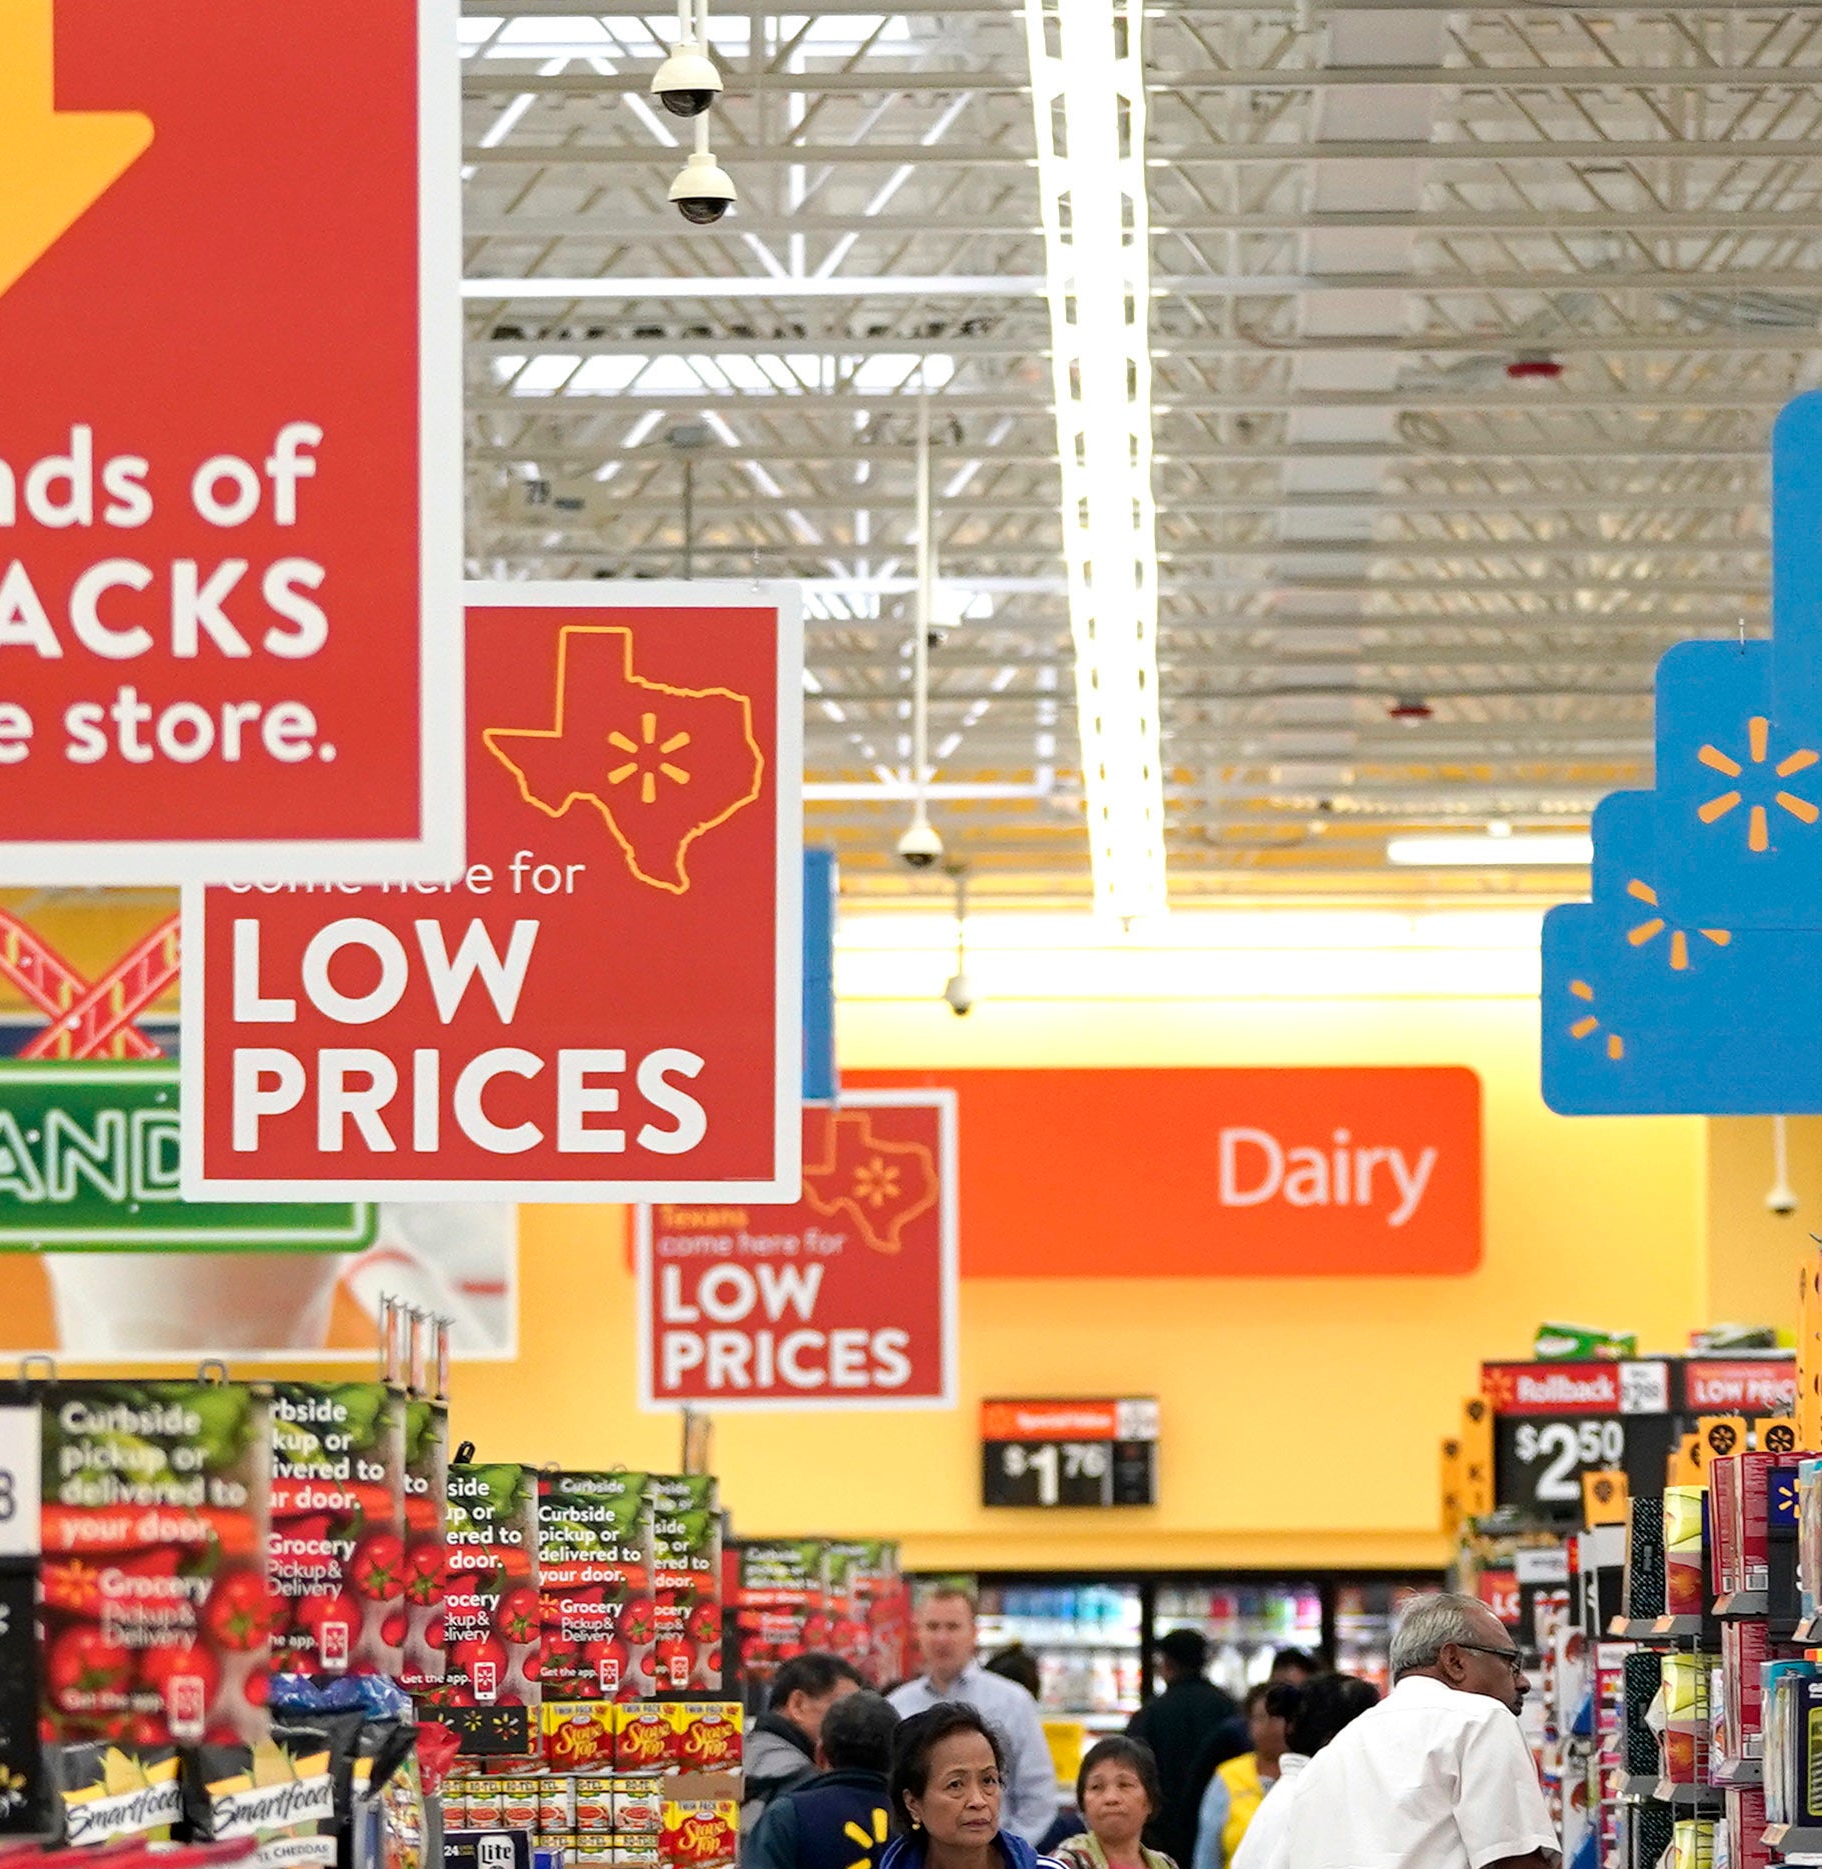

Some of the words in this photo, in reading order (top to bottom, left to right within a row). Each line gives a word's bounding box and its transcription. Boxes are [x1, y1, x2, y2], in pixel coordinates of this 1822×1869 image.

[191, 423, 324, 527] of
[66, 687, 335, 765] store.
[509, 851, 586, 895] for
[232, 916, 540, 1025] LOW
[232, 1048, 708, 1154] PRICES
[1218, 1126, 1437, 1228] Dairy
[659, 1204, 748, 1231] Texans
[659, 1235, 728, 1257] come
[737, 1230, 795, 1257] here
[803, 1230, 846, 1256] for
[660, 1264, 825, 1324] LOW
[661, 1329, 911, 1389] PRICES
[59, 1401, 201, 1436] Curbside
[325, 1434, 353, 1450] or
[60, 1439, 167, 1476] pickup
[171, 1448, 208, 1470] or
[1515, 1420, 1625, 1499] $250
[357, 1463, 385, 1480] to
[405, 1476, 428, 1493] to
[59, 1475, 205, 1506] delivered
[209, 1478, 247, 1507] to
[294, 1486, 360, 1510] door.
[560, 1480, 625, 1494] Curbside
[472, 1506, 495, 1519] or
[538, 1506, 615, 1522] Curbside
[59, 1517, 132, 1549] your
[137, 1511, 218, 1542] door.
[498, 1528, 522, 1545] to
[539, 1528, 596, 1545] pickup
[600, 1531, 620, 1542] or
[268, 1533, 356, 1561] Grocery
[449, 1551, 503, 1569] door.
[539, 1548, 618, 1562] delivered
[622, 1549, 641, 1562] to
[539, 1569, 577, 1586] your
[581, 1567, 626, 1582] door.
[692, 1558, 710, 1570] to
[98, 1568, 214, 1606] Grocery
[560, 1599, 623, 1617] Grocery
[561, 1629, 614, 1644] Delivery
[481, 1844, 512, 1864] Lite
